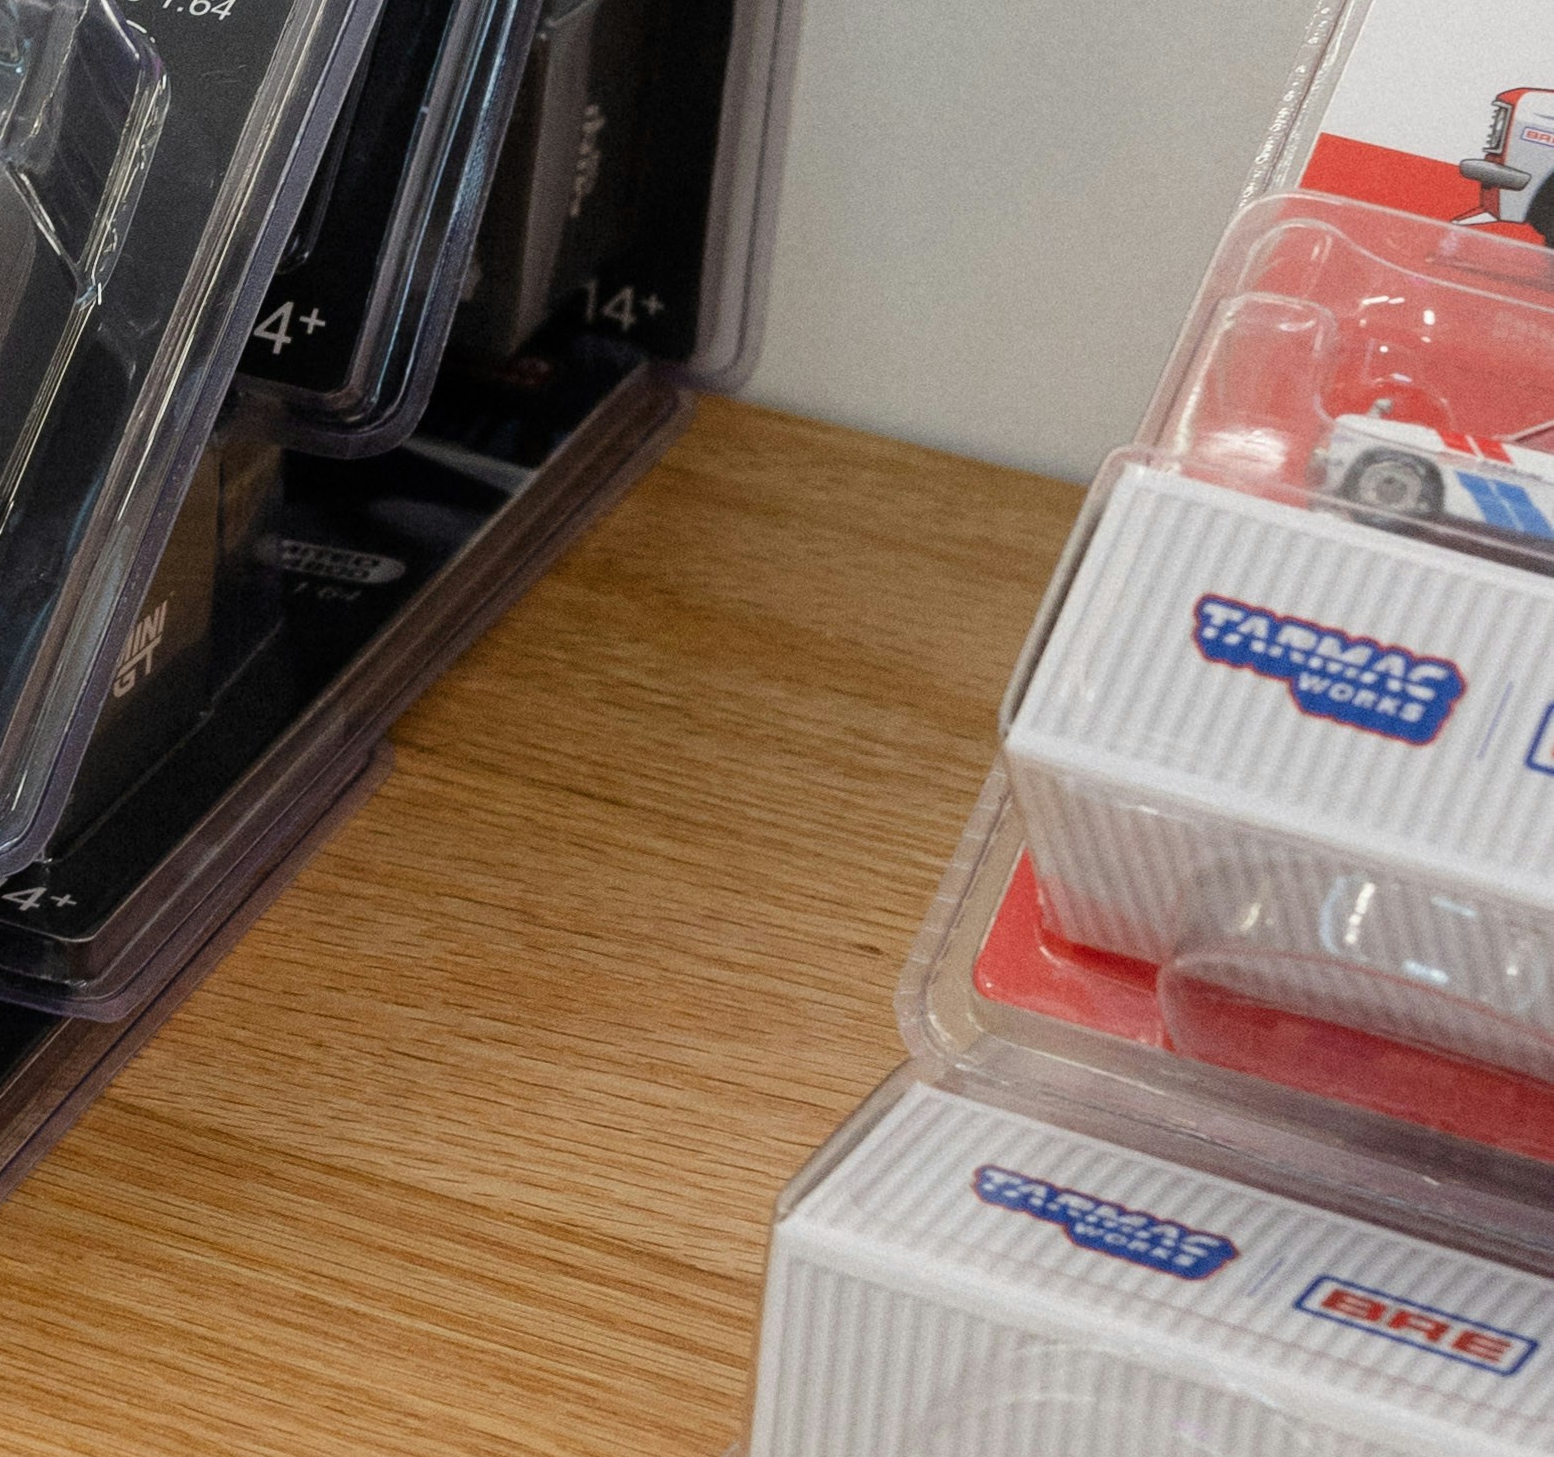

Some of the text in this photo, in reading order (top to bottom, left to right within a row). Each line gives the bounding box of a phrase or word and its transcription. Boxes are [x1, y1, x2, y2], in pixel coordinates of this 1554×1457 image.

[113, 635, 162, 698] GT
[1202, 602, 1450, 702] TARMAC
[1297, 671, 1426, 723] WORKS
[981, 1170, 1222, 1260] TARMAC
[1073, 1221, 1196, 1269] WORKS
[1319, 1288, 1512, 1364] BRE
